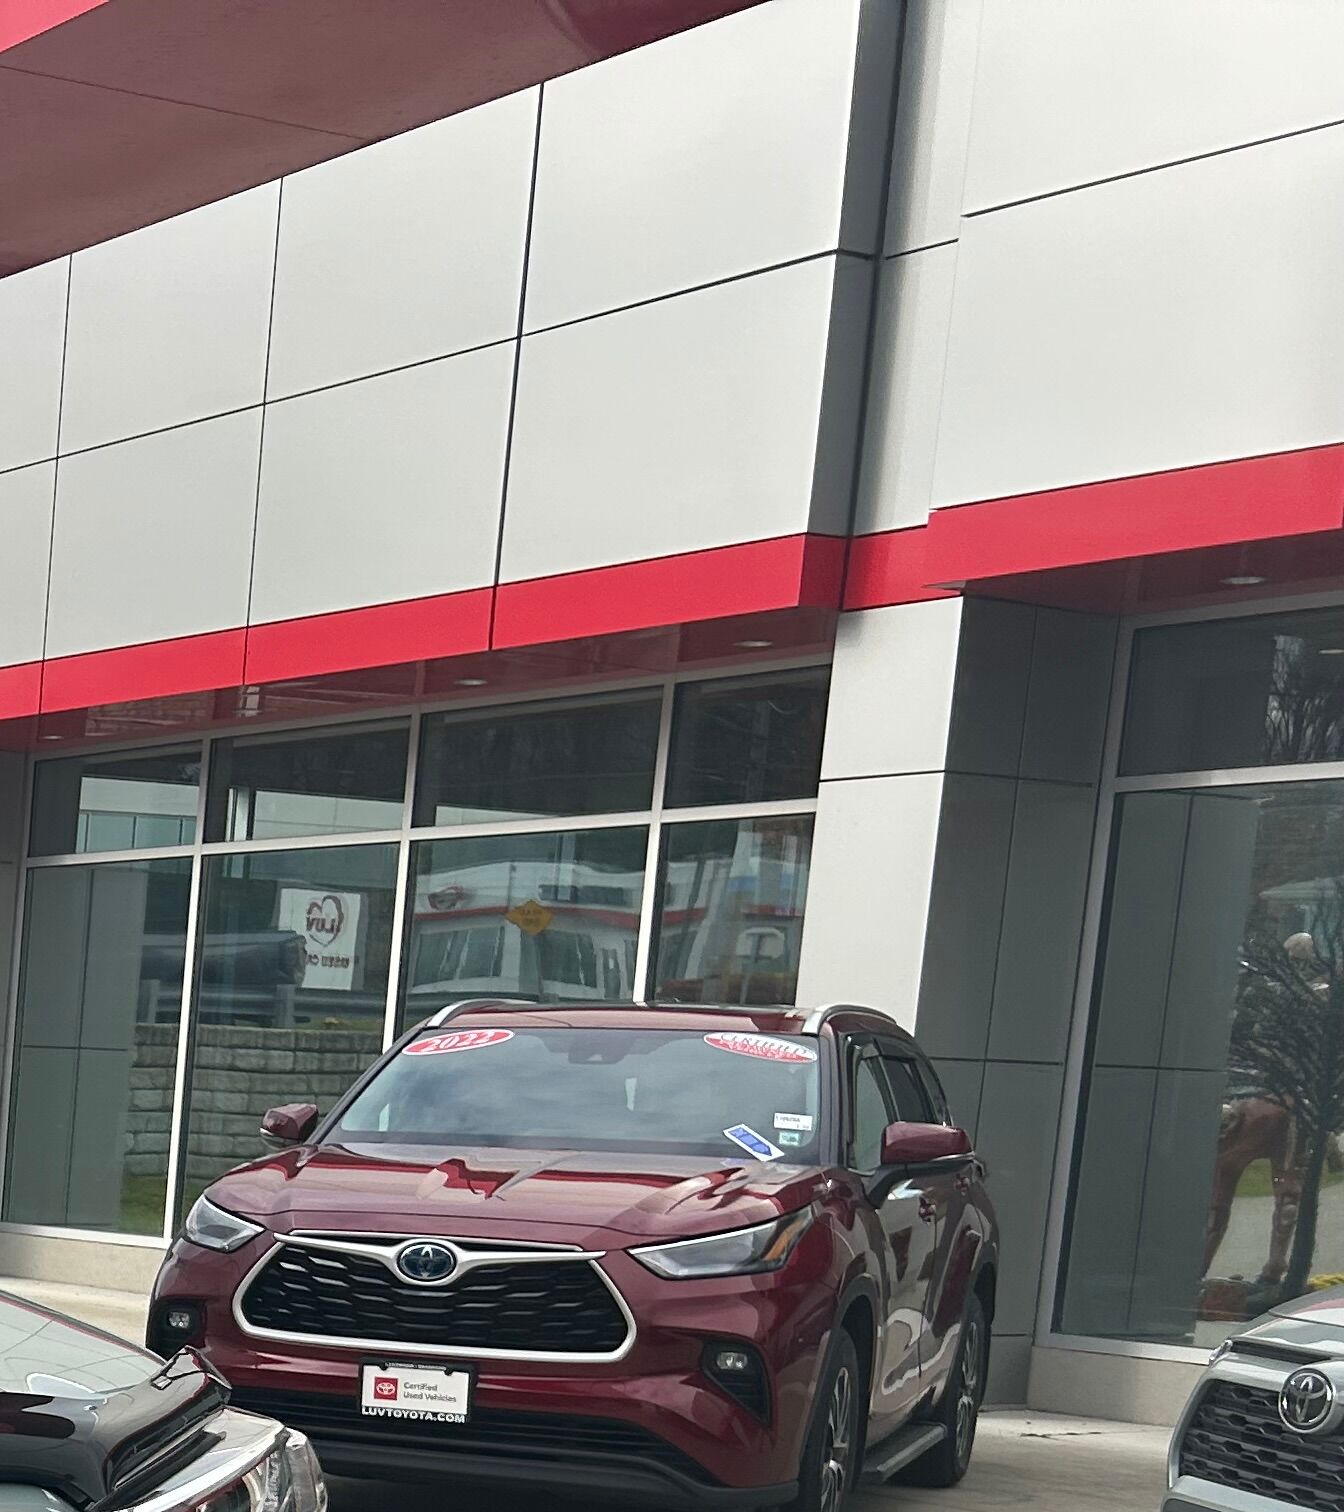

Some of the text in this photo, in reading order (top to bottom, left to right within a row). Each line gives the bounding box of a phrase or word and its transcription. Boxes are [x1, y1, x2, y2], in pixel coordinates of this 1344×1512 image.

[404, 1382, 438, 1392] Certified
[403, 1391, 424, 1400] Used
[361, 1405, 466, 1424] LUVTOYOTA.COM
